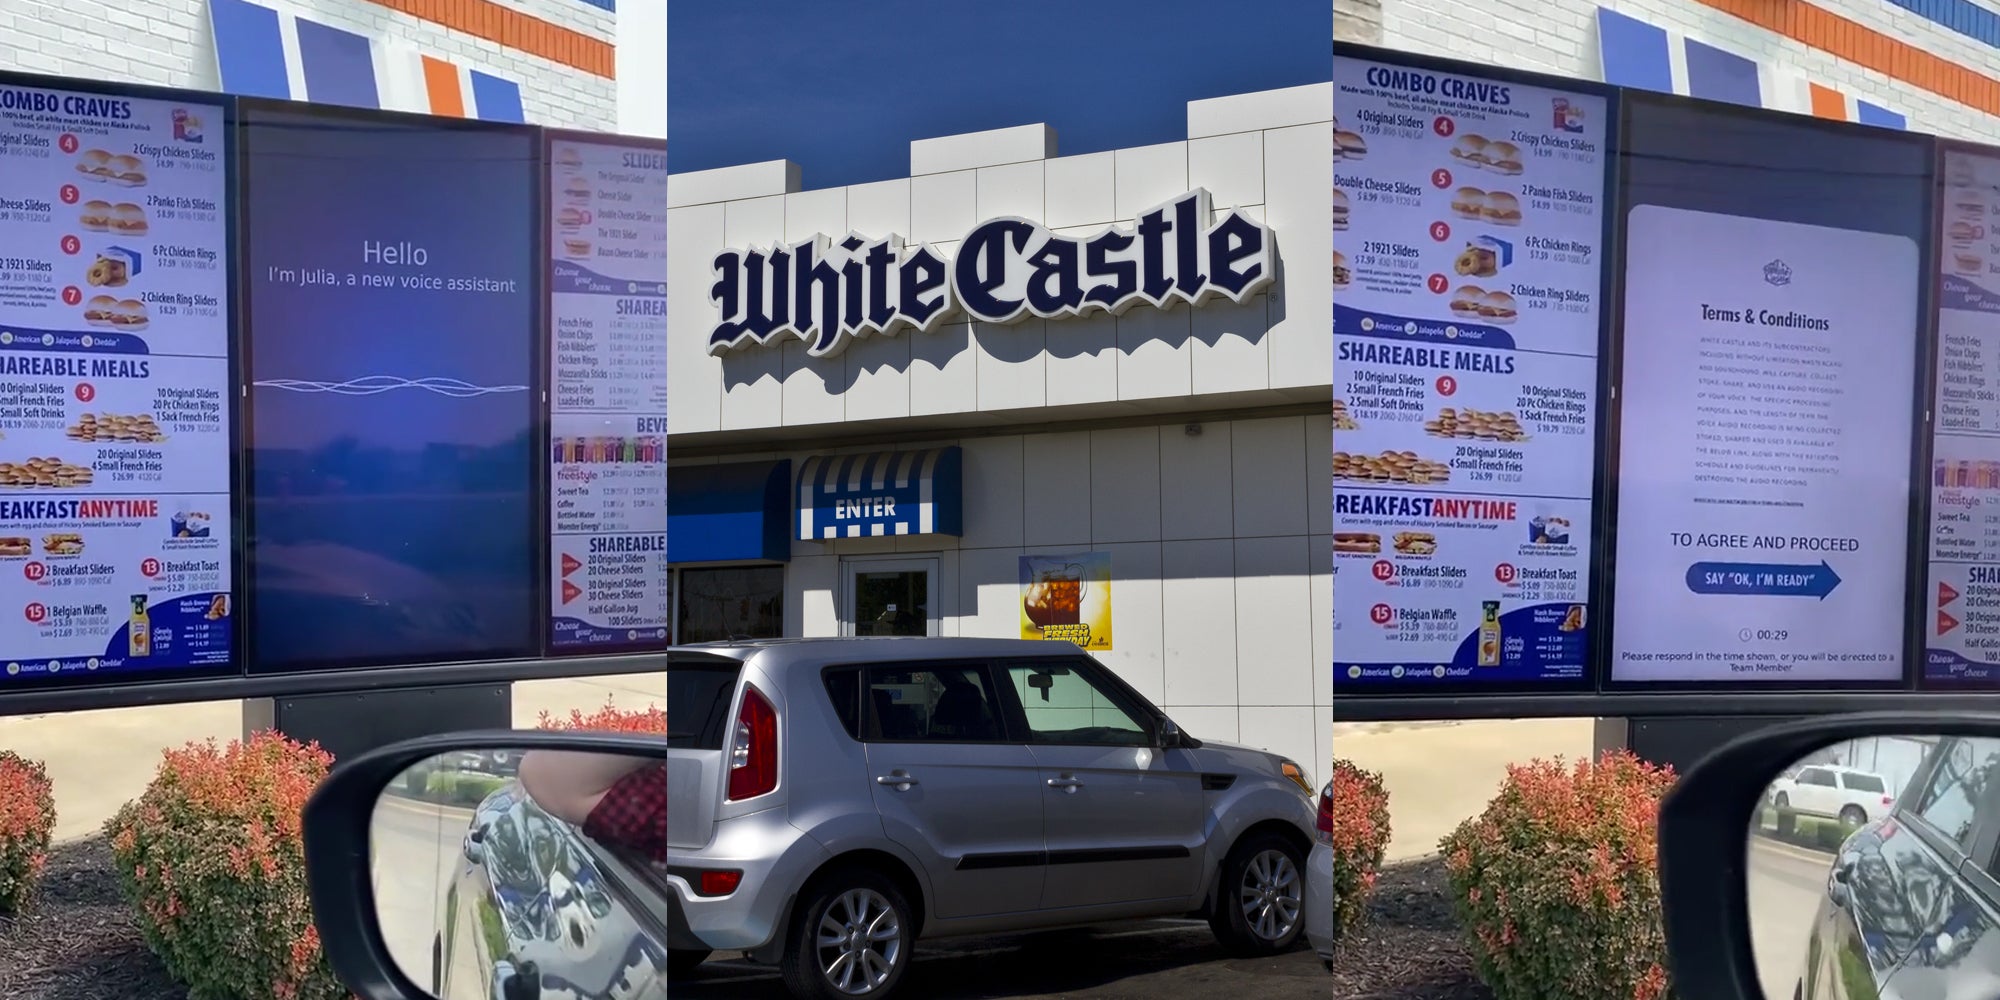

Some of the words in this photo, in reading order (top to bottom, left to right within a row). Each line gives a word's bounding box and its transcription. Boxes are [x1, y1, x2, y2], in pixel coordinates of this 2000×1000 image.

[1367, 67, 1436, 93] COMBO
[1441, 78, 1511, 105] CRAVES
[0, 89, 59, 113] OMBO
[64, 96, 131, 120] CRAVES
[1341, 85, 1358, 93] Made
[1360, 88, 1375, 96] with
[1420, 96, 1438, 104] white
[1440, 99, 1456, 107] meat
[1457, 101, 1479, 110] chicken
[1488, 106, 1507, 115] Alaska
[1363, 111, 1396, 126] Original
[1397, 116, 1424, 129] Sliders
[23, 134, 50, 147] Sliders
[1517, 132, 1539, 146] Crispy
[1541, 134, 1569, 149] Chicken
[1571, 139, 1595, 153] Sliders
[139, 144, 162, 157] Crispy
[163, 144, 190, 158] Chicken
[191, 148, 216, 161] Sliders
[1334, 174, 1363, 188] Double
[1365, 178, 1393, 192] Cheese
[1394, 182, 1422, 196] Sliders
[1438, 173, 1446, 184] 5
[1528, 186, 1551, 199] Panko
[1552, 190, 1568, 201] Fish
[1569, 191, 1593, 204] Sliders
[25, 200, 51, 212] Sliders
[153, 196, 175, 208] Panko
[176, 198, 191, 209] Fish
[192, 199, 216, 211] Sliders
[168, 246, 196, 259] Chicken
[197, 249, 217, 262] Rings
[364, 240, 427, 265] Hello
[1370, 242, 1391, 255] 1921
[1392, 245, 1420, 258] Sliders
[1541, 239, 1570, 251] Chicken
[1571, 242, 1591, 255] Rings
[6, 258, 25, 270] 1921
[26, 260, 52, 272] Sliders
[268, 266, 295, 282] I'm
[300, 268, 341, 287] Julia,
[346, 273, 356, 285] a
[362, 274, 395, 288] new
[400, 276, 442, 289] voice
[447, 276, 515, 293] assistant
[709, 238, 950, 353] White
[955, 193, 1264, 320] Castle
[147, 292, 175, 304] Chicken
[176, 294, 193, 307] Ring
[194, 296, 218, 307] Sliders
[1517, 285, 1546, 298] Chicken
[1547, 287, 1564, 301] Ring
[1566, 289, 1590, 302] Sliders
[1701, 304, 1741, 323] Terms
[1745, 309, 1755, 324] &
[1759, 309, 1829, 331] Conditions
[558, 355, 581, 365] Chicken
[1338, 342, 1450, 369] SHAREABLE
[1455, 353, 1515, 374] MEALS
[92, 359, 150, 378] MEALS
[1365, 371, 1397, 385] Original
[1398, 374, 1424, 386] Sliders
[7, 383, 37, 395] Original
[39, 384, 65, 394] Sliders
[1353, 384, 1376, 396] Small
[1377, 386, 1405, 398] French
[1406, 388, 1424, 399] Fries
[1443, 380, 1450, 392] 9
[1533, 386, 1561, 398] Original
[1562, 388, 1586, 400] Sliders
[20, 396, 45, 406] French
[167, 388, 195, 400] Original
[196, 389, 219, 399] Sliders
[172, 401, 199, 411] Chicken
[1356, 397, 1379, 409] Small
[1380, 398, 1398, 410] Soft
[1400, 399, 1424, 411] Drinks
[1537, 399, 1565, 410] Chicken
[1567, 401, 1586, 413] Rings
[1, 408, 22, 418] Small
[41, 408, 65, 418] Drinks
[1543, 411, 1567, 423] French
[1568, 413, 1585, 424] Fries
[109, 450, 137, 461] Original
[138, 450, 162, 460] Sliders
[1467, 447, 1495, 459] Original
[1497, 448, 1523, 459] Sliders
[1456, 459, 1477, 470] Small
[1479, 460, 1504, 470] French
[557, 470, 598, 483] freestyle
[835, 497, 896, 519] ENTER
[1938, 495, 1980, 509] freestyle
[1938, 513, 1958, 521] Sweet
[1959, 513, 1970, 521] Tea
[589, 536, 665, 553] SHAREABLE
[1671, 533, 1692, 547] TO
[1697, 534, 1748, 548] AGREE
[1753, 536, 1785, 549] AND
[1791, 537, 1859, 552] PROCEED
[167, 562, 200, 571] Breakfast
[202, 561, 219, 571] Toast
[597, 555, 624, 565] Original
[624, 553, 646, 563] Sliders
[52, 565, 88, 575] Breakfast
[90, 564, 115, 574] Sliders
[597, 566, 620, 575] Cheese
[621, 564, 643, 574] Sliders
[1375, 565, 1389, 576] 12
[1402, 565, 1438, 577] Breakfast
[1440, 566, 1466, 578] Sliders
[1499, 567, 1511, 578] 13
[1522, 568, 1557, 579] Breakfast
[1559, 569, 1577, 579] Toast
[597, 580, 624, 590] Original
[624, 579, 646, 589] Sliders
[1706, 572, 1725, 584] SAY
[1756, 573, 1774, 586] I'M
[1777, 574, 1815, 587] READY"
[597, 591, 620, 600] Cheese
[621, 590, 643, 599] Sliders
[53, 606, 81, 619] Belgian
[83, 605, 107, 615] Waffle
[603, 605, 625, 613] Gallon
[1374, 608, 1388, 619] 15
[1400, 609, 1430, 622] Belgian
[1432, 609, 1456, 621] Waffle
[1043, 629, 1089, 638] FRESH
[1757, 630, 1788, 640] 00:29
[1965, 640, 1979, 648] Half
[1622, 652, 1653, 661] Please
[1655, 652, 1692, 663] respond
[1695, 652, 1704, 660] in
[1706, 652, 1721, 661] the
[1723, 652, 1744, 661] time
[1792, 654, 1808, 663] you
[1810, 652, 1824, 661] will
[1827, 653, 1838, 661] be
[1841, 653, 1876, 661] directed
[1878, 653, 1887, 661] to
[1730, 663, 1753, 672] Team
